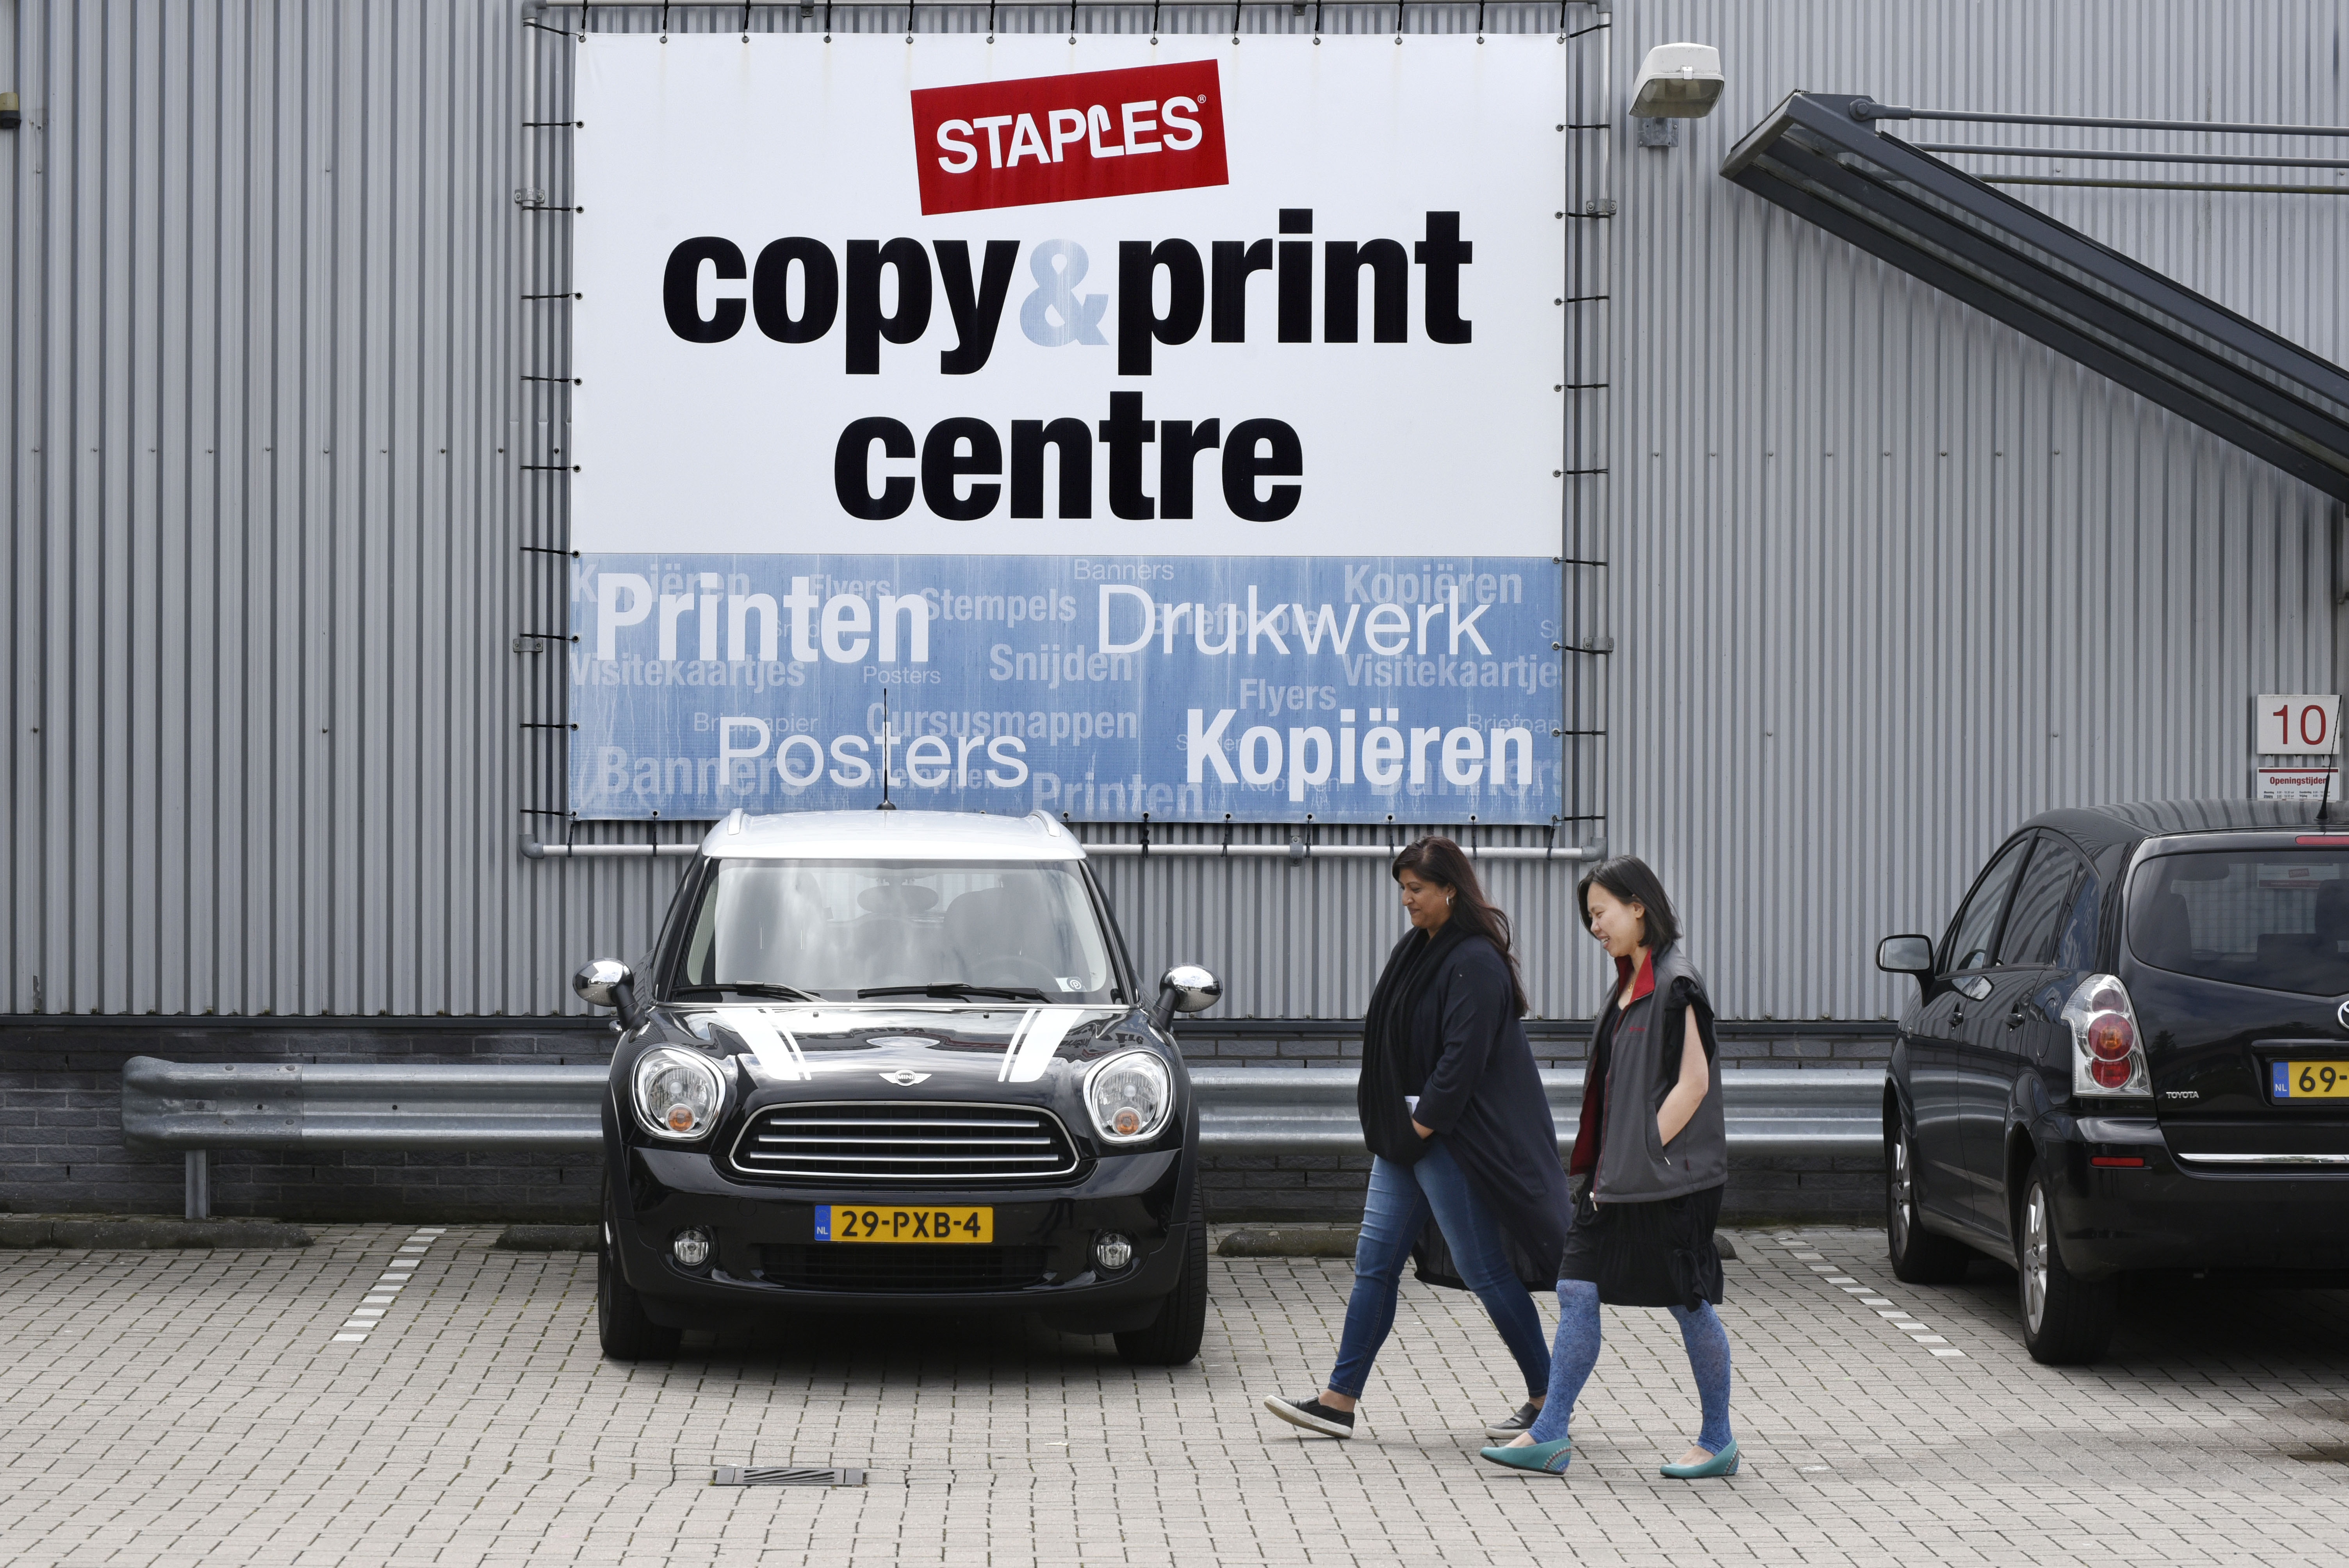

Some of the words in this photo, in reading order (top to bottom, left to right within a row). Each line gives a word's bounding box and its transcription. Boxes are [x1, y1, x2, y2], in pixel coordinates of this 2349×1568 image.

[663, 209, 1473, 375] copy&print
[835, 392, 1302, 522] centre
[1074, 559, 1174, 581] Banners
[1344, 564, 1522, 606] Kopiëren
[597, 573, 929, 663] Printen
[920, 587, 1077, 628] Stempels
[1100, 584, 1491, 655] Drukwerk
[570, 653, 806, 693] Visitekaartjes
[863, 666, 941, 684] Posters
[989, 643, 1132, 690] Snijden
[1342, 654, 1562, 695] Visitekaartje
[1240, 679, 1337, 716] Flyers
[866, 702, 1137, 746] Cursusmappen
[2273, 704, 2326, 745] 10
[720, 717, 1028, 787] Posters
[1187, 708, 1532, 802] Kopiëren
[1032, 772, 1203, 818] Printen
[2275, 1083, 2287, 1092] NL
[816, 1227, 829, 1235] NL
[841, 1211, 981, 1237] 29-PXB-4
